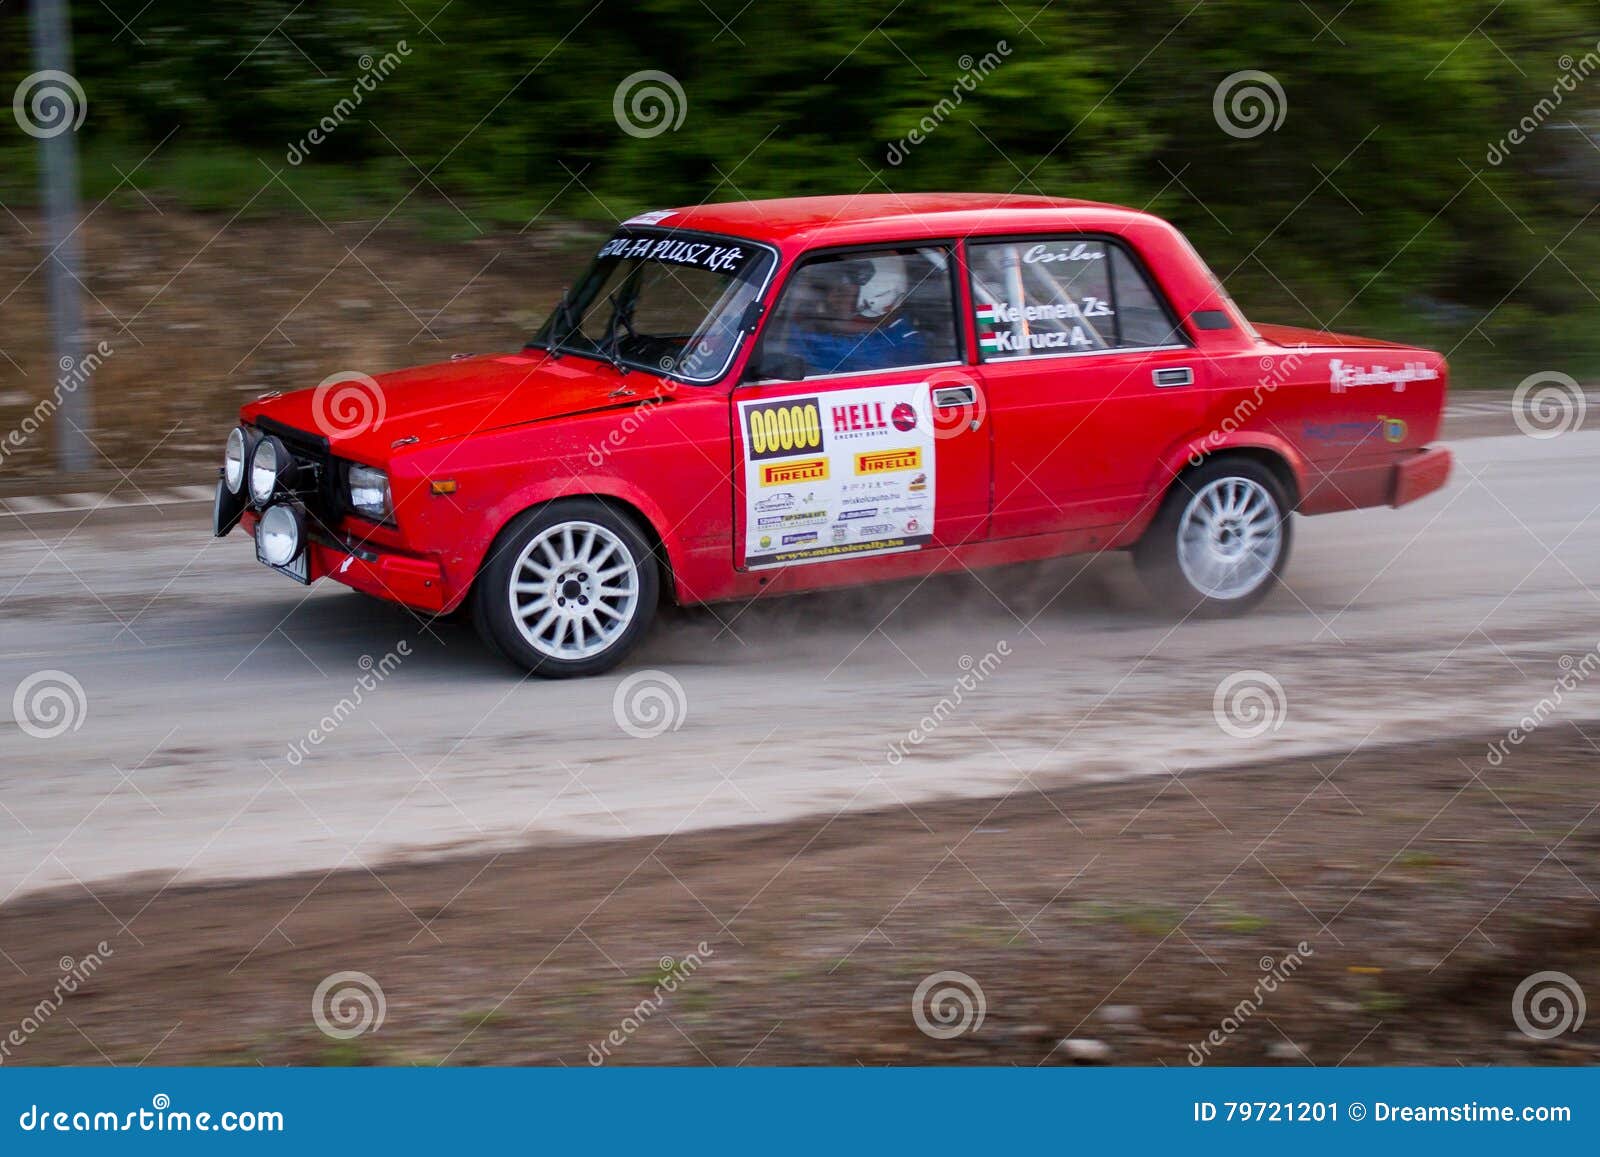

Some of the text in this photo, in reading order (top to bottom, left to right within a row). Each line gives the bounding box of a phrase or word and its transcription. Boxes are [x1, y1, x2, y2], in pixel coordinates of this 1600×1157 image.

[648, 239, 712, 264] PLUSZ
[995, 330, 1069, 352] Kurucz
[832, 403, 887, 432] HELL
[765, 461, 825, 483] PIRELLI
[859, 451, 917, 472] PIRELLI
